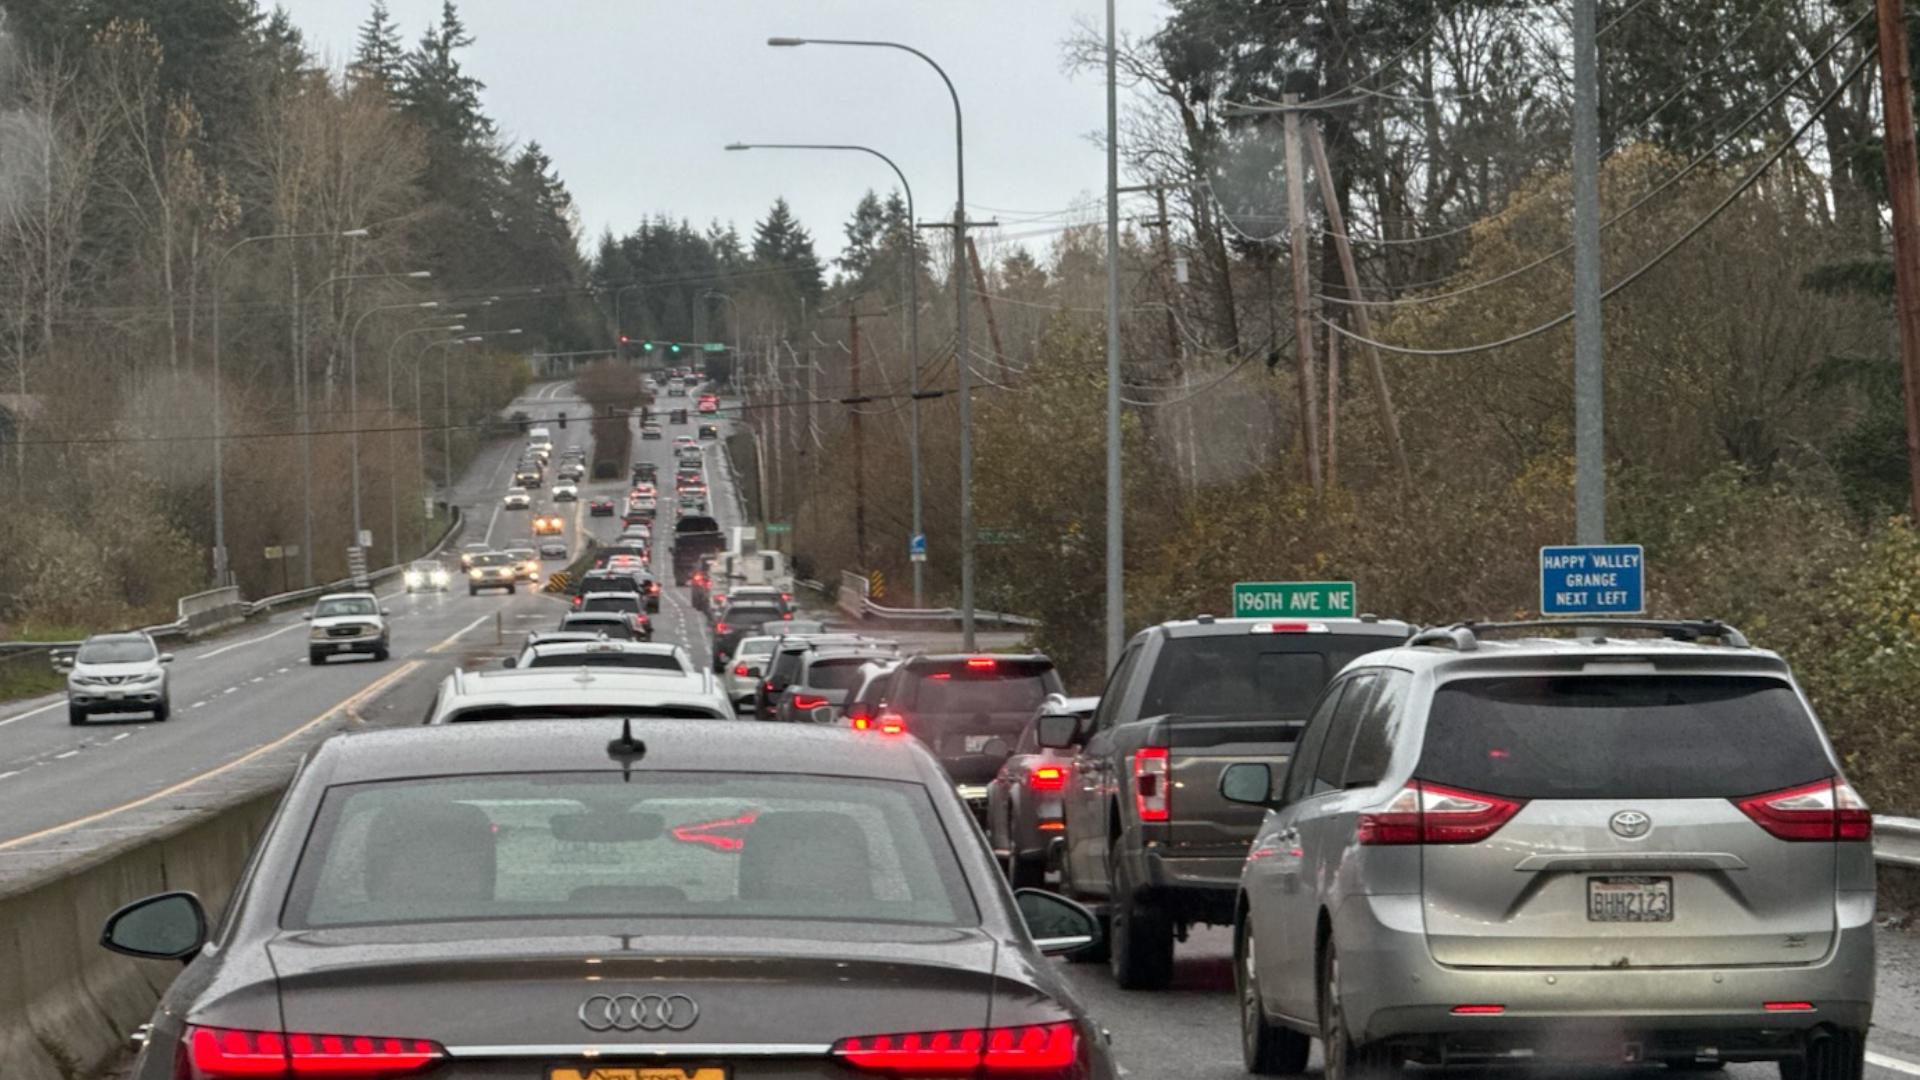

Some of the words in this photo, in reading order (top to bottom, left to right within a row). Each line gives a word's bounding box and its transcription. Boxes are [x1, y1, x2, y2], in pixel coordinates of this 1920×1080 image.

[1544, 556, 1586, 569] HAPPY
[1593, 555, 1639, 568] VALLEY
[1566, 573, 1618, 587] GRANGE
[1238, 592, 1283, 610] 196TH
[1290, 592, 1320, 610] AVE
[1328, 591, 1350, 609] NE
[1556, 591, 1588, 606] NEXT
[1597, 591, 1627, 605] LEFT
